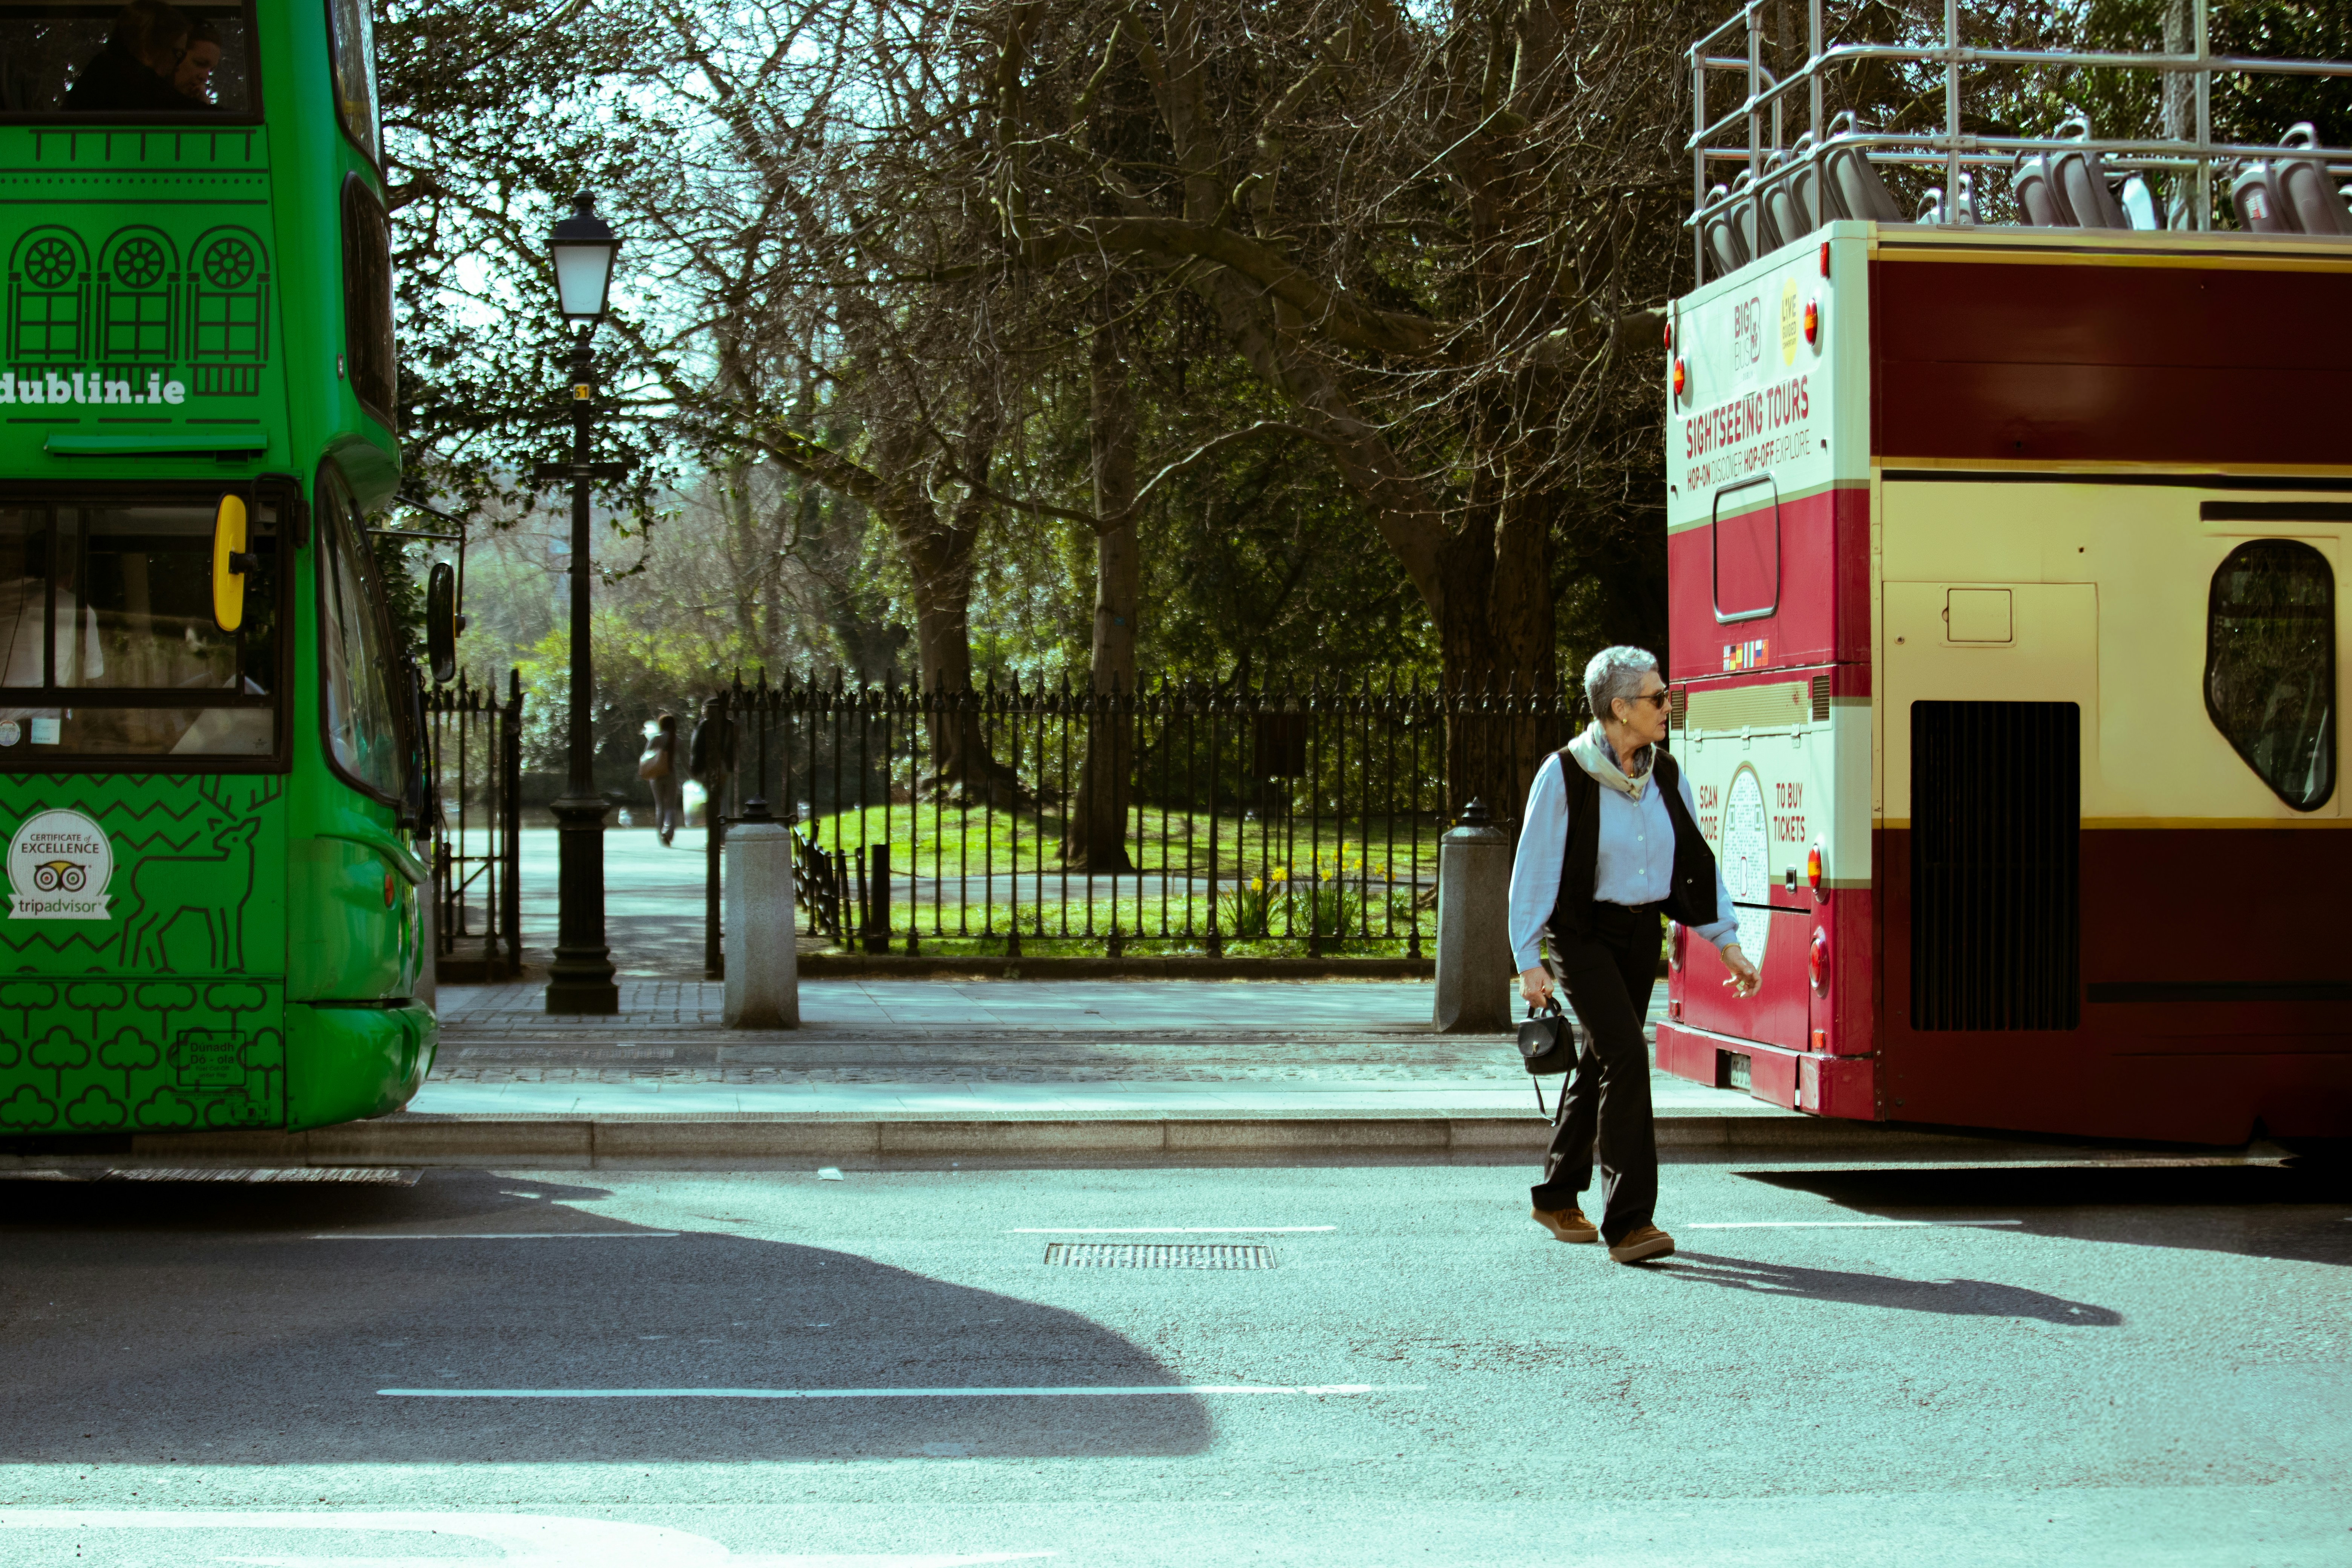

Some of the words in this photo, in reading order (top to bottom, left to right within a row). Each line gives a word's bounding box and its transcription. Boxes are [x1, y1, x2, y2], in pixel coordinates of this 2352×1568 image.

[1735, 301, 1749, 339] BIG
[1782, 321, 1796, 340] GUIDED
[1735, 337, 1750, 371] BUS
[1782, 337, 1796, 350] COMMENTARY
[0, 372, 185, 404] dublin.ie
[1743, 371, 1753, 381] DUBLIN
[1686, 392, 1762, 460] SIGHTSEEING
[1767, 375, 1808, 431] TOURS
[1687, 462, 1710, 492] HOP-ON
[1712, 451, 1742, 484] DISCOVER
[1744, 440, 1774, 474] HOP-OFF
[1776, 429, 1810, 464] EXPLORE
[1700, 785, 1717, 810] SCAN
[1776, 783, 1785, 809] TO
[1788, 782, 1802, 810] BUY
[1773, 816, 1805, 843] TICKETS
[21, 843, 99, 854] EXCELLENCE
[191, 1042, 234, 1052] Dúnadh
[191, 1055, 206, 1064] Dó
[217, 1055, 234, 1064] ola
